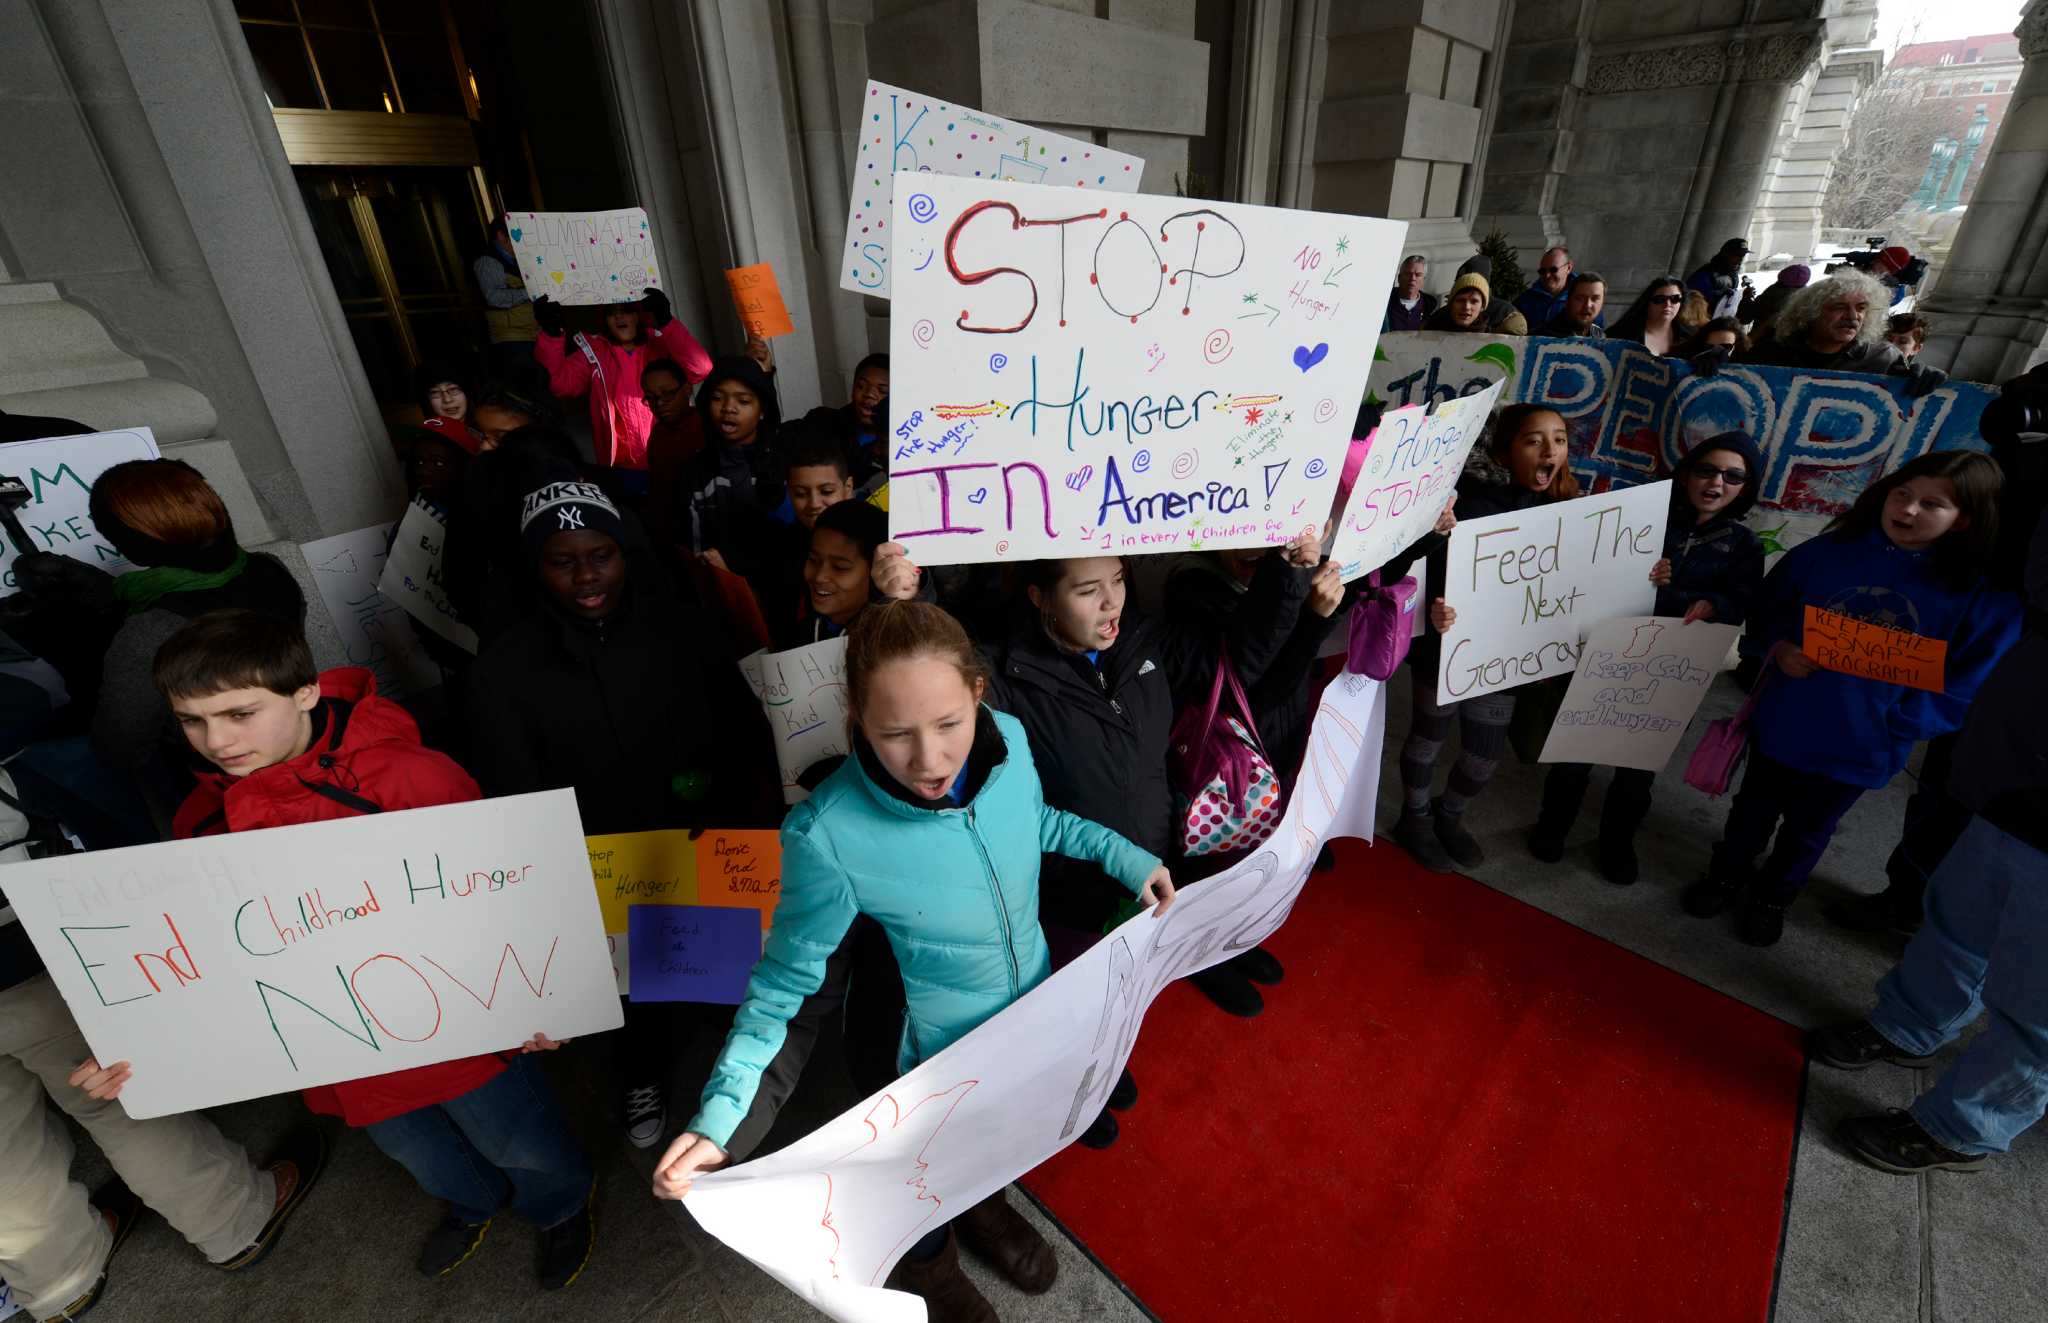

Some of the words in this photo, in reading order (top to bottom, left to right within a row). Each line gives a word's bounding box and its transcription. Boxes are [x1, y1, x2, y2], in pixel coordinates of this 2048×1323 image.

[944, 200, 1245, 334] STOP
[1293, 245, 1321, 271] NO
[1288, 279, 1341, 321] Hunger!
[896, 410, 924, 440] STOP
[1528, 343, 1960, 504] PEOPL
[1120, 534, 1136, 547] in
[1141, 531, 1180, 546] every
[1187, 529, 1195, 540] 4
[1473, 517, 1562, 592] Feed
[1584, 505, 1654, 564] The
[1521, 577, 1586, 626] Next
[1815, 607, 1869, 635] KEEP
[1883, 628, 1932, 652] THE
[1834, 632, 1904, 661] SNAP
[1446, 632, 1586, 697] Generat
[1584, 650, 1645, 682] Keep
[1647, 654, 1710, 687] Calm
[1593, 678, 1660, 704] and
[594, 867, 612, 880] hild
[615, 872, 680, 900] Hunger!
[60, 913, 203, 1007] End
[235, 880, 381, 957] Childhood
[403, 853, 534, 905] Hunger
